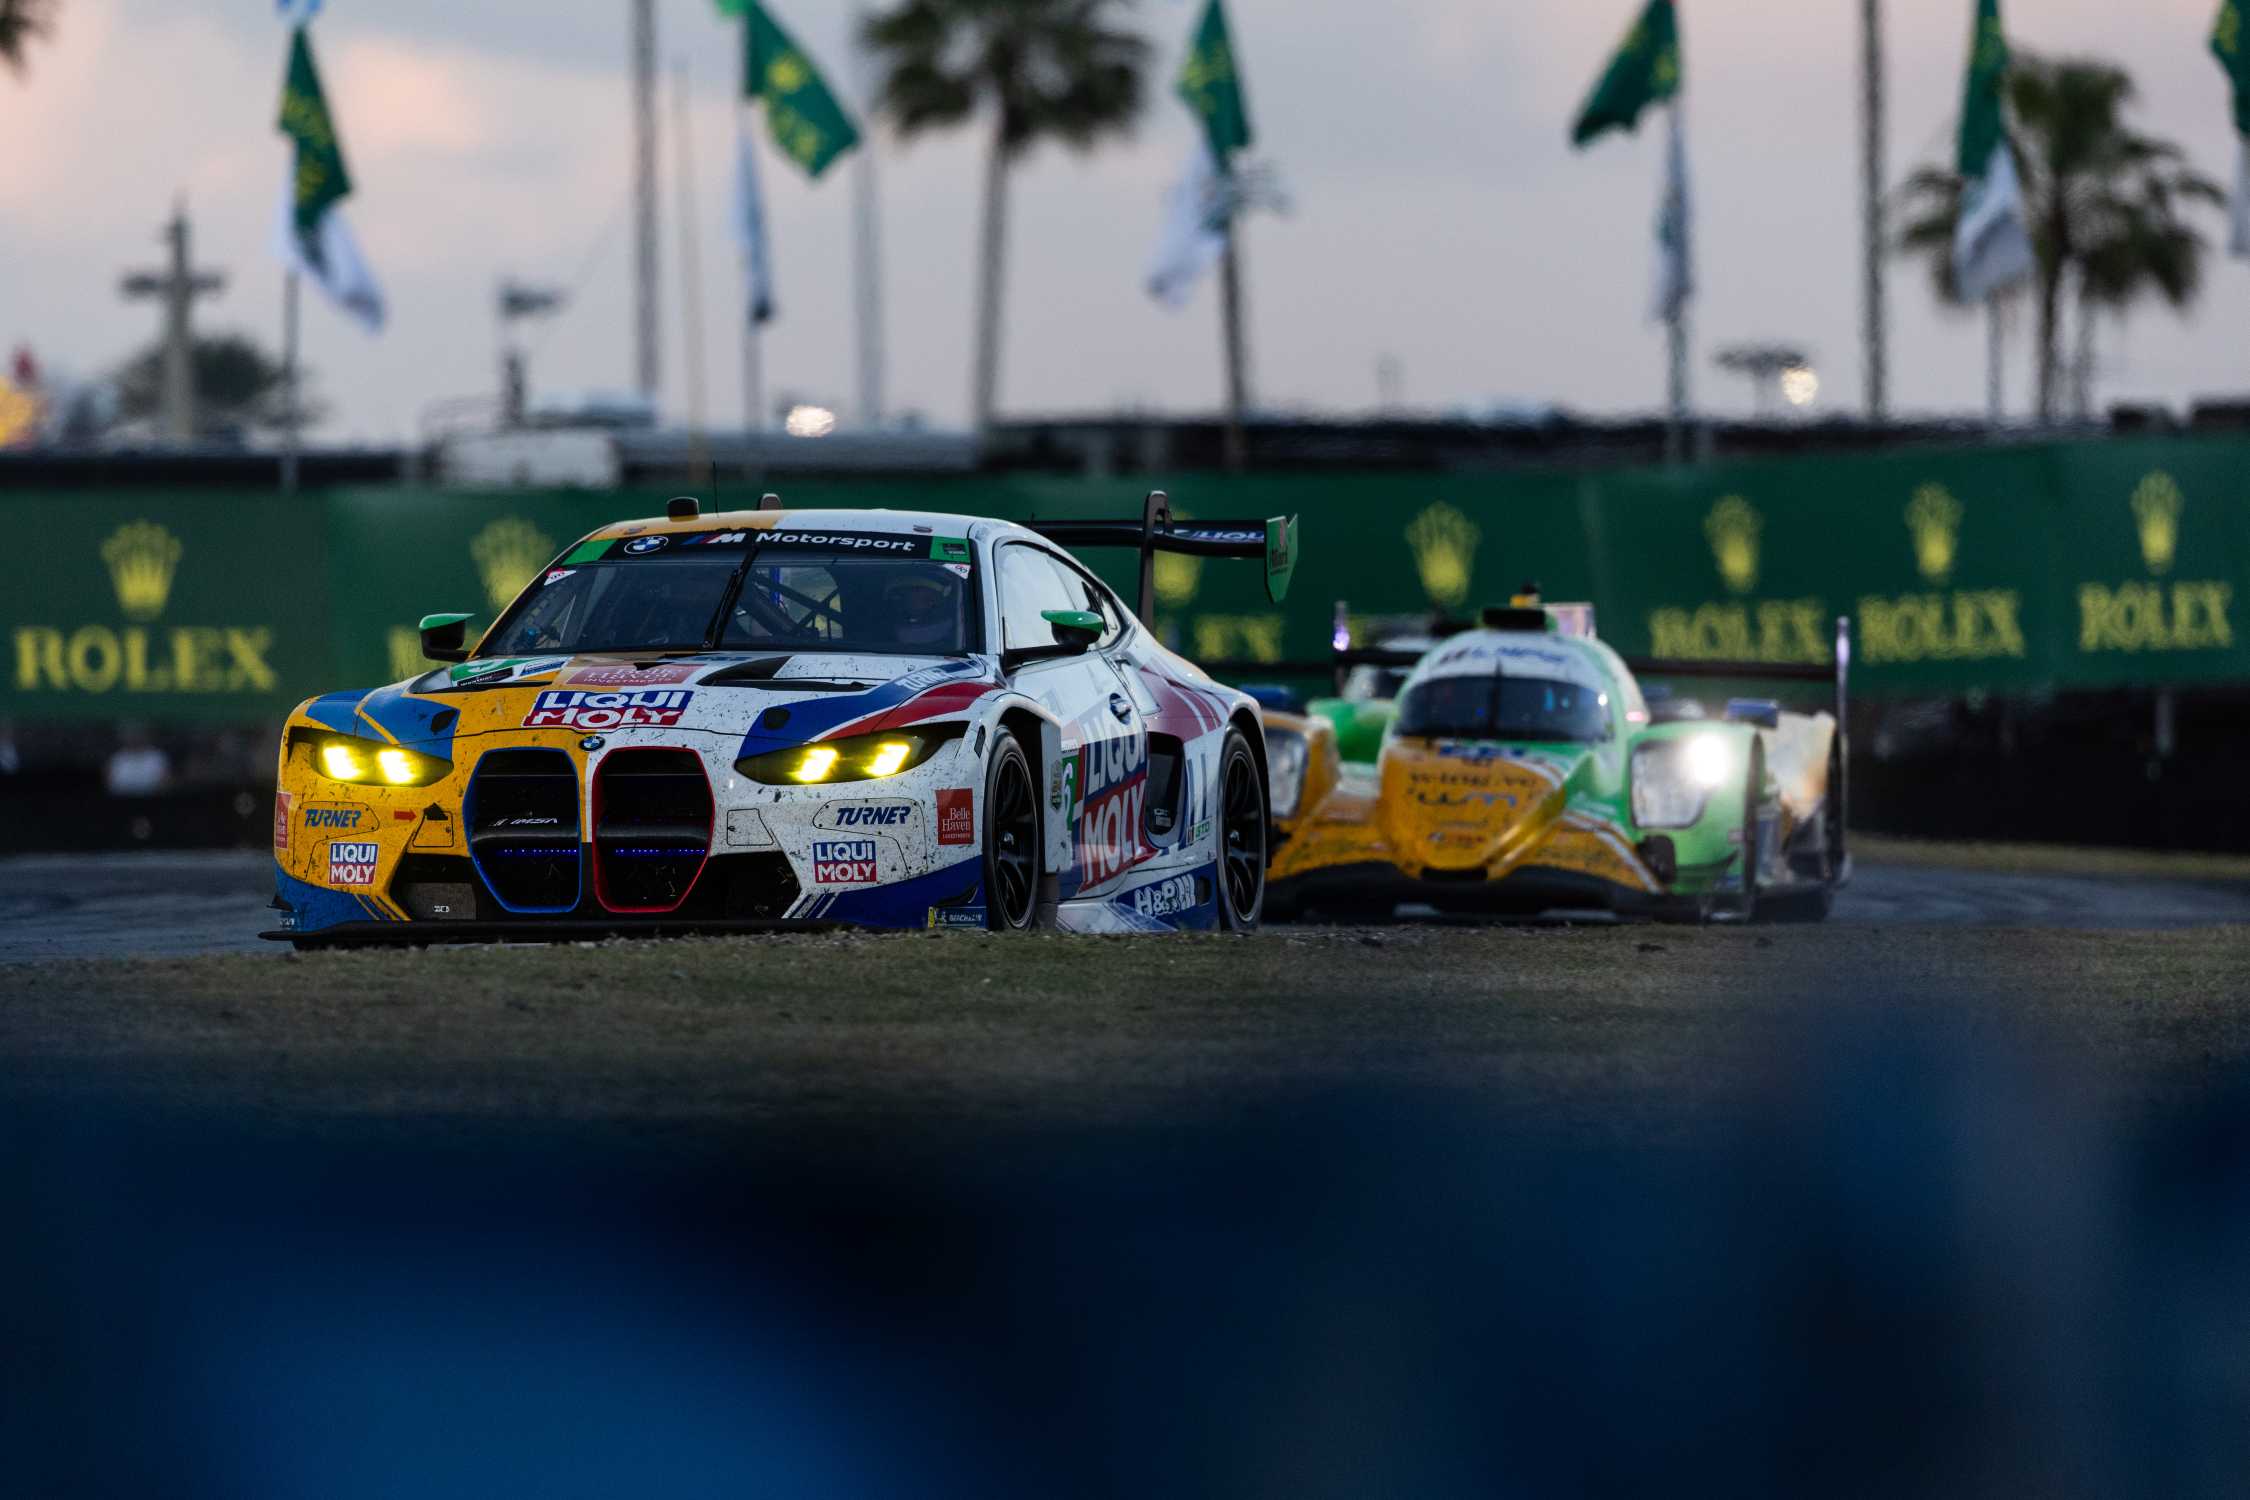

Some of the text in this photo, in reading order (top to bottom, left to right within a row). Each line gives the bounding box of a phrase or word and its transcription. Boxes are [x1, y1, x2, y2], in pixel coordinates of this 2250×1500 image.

[755, 531, 915, 552] Motorsport
[2079, 582, 2232, 651] ROLEX
[1650, 604, 1829, 664] ROLEX
[1858, 592, 2024, 664] ROLEX
[14, 626, 276, 691] ROLEX
[542, 691, 686, 709] LIQUI
[531, 707, 683, 728] MOLY
[1083, 706, 1146, 796] LIQUI
[304, 808, 362, 828] TURNER
[835, 806, 911, 826] TURNER
[950, 807, 970, 820] Belle
[942, 818, 970, 832] Haven
[1083, 779, 1146, 883] MOLY
[332, 844, 375, 863] LIQUI
[816, 842, 874, 862] LIQUI
[331, 864, 375, 883] MOLY
[818, 863, 876, 881] MOLY
